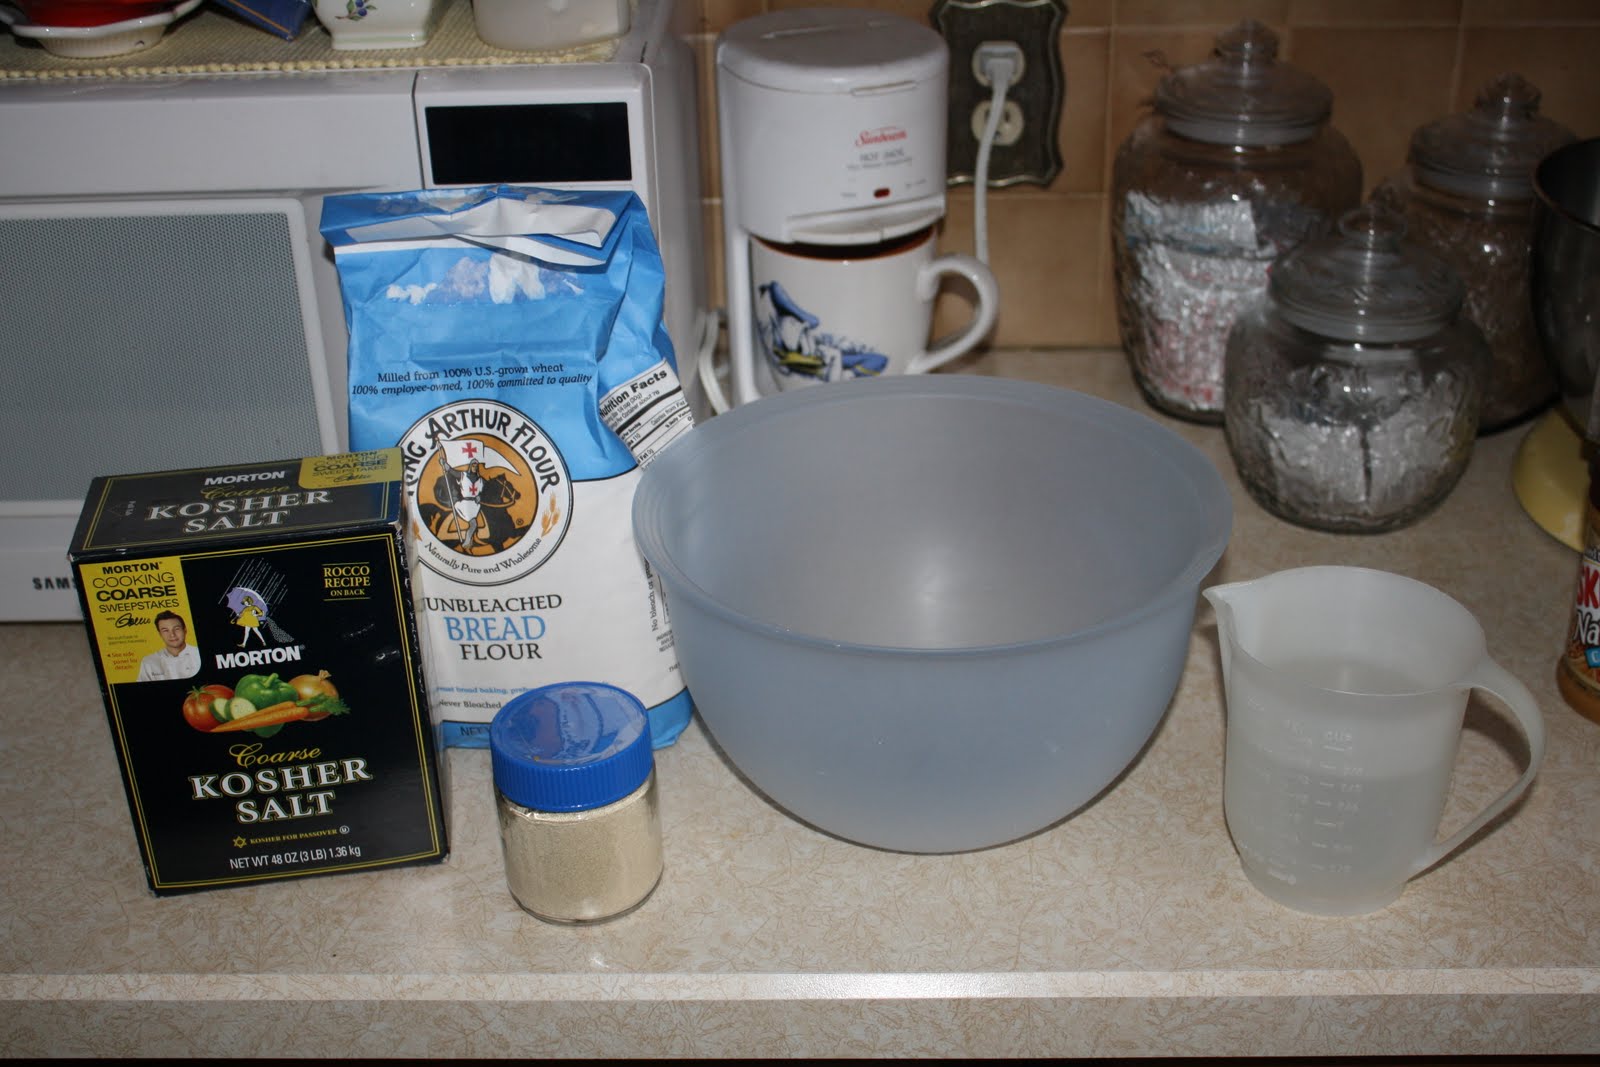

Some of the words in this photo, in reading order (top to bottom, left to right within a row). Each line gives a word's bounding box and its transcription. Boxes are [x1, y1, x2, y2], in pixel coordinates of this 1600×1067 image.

[378, 371, 410, 382] Milled
[414, 371, 439, 380] from
[443, 368, 472, 378] 100%
[475, 365, 528, 377] U.S.-grown
[532, 363, 564, 373] wheat
[630, 370, 668, 393] Facts
[352, 385, 378, 395] 100%
[381, 381, 463, 396] employee-owned,
[467, 379, 494, 390] 100%
[497, 376, 544, 388] committed
[547, 375, 556, 384] to
[558, 374, 592, 386] quality
[425, 408, 512, 450] ARTHUR
[510, 421, 560, 494] FLOUR
[313, 459, 387, 472] COARSE
[205, 471, 286, 486] MORTON
[201, 485, 291, 500] Coarse
[147, 491, 331, 520] KOSHER
[184, 510, 289, 533] SALT
[424, 541, 460, 570] Naturally
[460, 563, 482, 574] Pure
[483, 564, 501, 574] and
[499, 537, 542, 570] Wholesome
[102, 562, 160, 574] MORTON
[324, 565, 370, 577] ROCCO
[92, 572, 175, 588] COOKING
[324, 577, 371, 588] RECIPE
[96, 585, 177, 602] COARSE
[98, 598, 180, 613] SWEEPSTAKES
[424, 594, 562, 613] UNBLEACHED
[444, 615, 546, 641] BREAD
[215, 645, 301, 669] MORTON
[460, 643, 542, 660] FLOUR
[438, 700, 461, 708] Never
[229, 743, 322, 768] Coarse
[189, 758, 373, 799] KOSHER
[236, 790, 336, 824] SALT
[250, 835, 282, 844] KOSHER
[299, 829, 338, 839] PASSOVER
[229, 857, 250, 869] NET
[251, 855, 269, 867] WT
[271, 854, 283, 865] 48
[284, 852, 299, 863] OZ
[299, 850, 309, 863] (3
[310, 848, 327, 861] LB)
[328, 846, 348, 858] 1.36
[349, 845, 361, 857] kg
